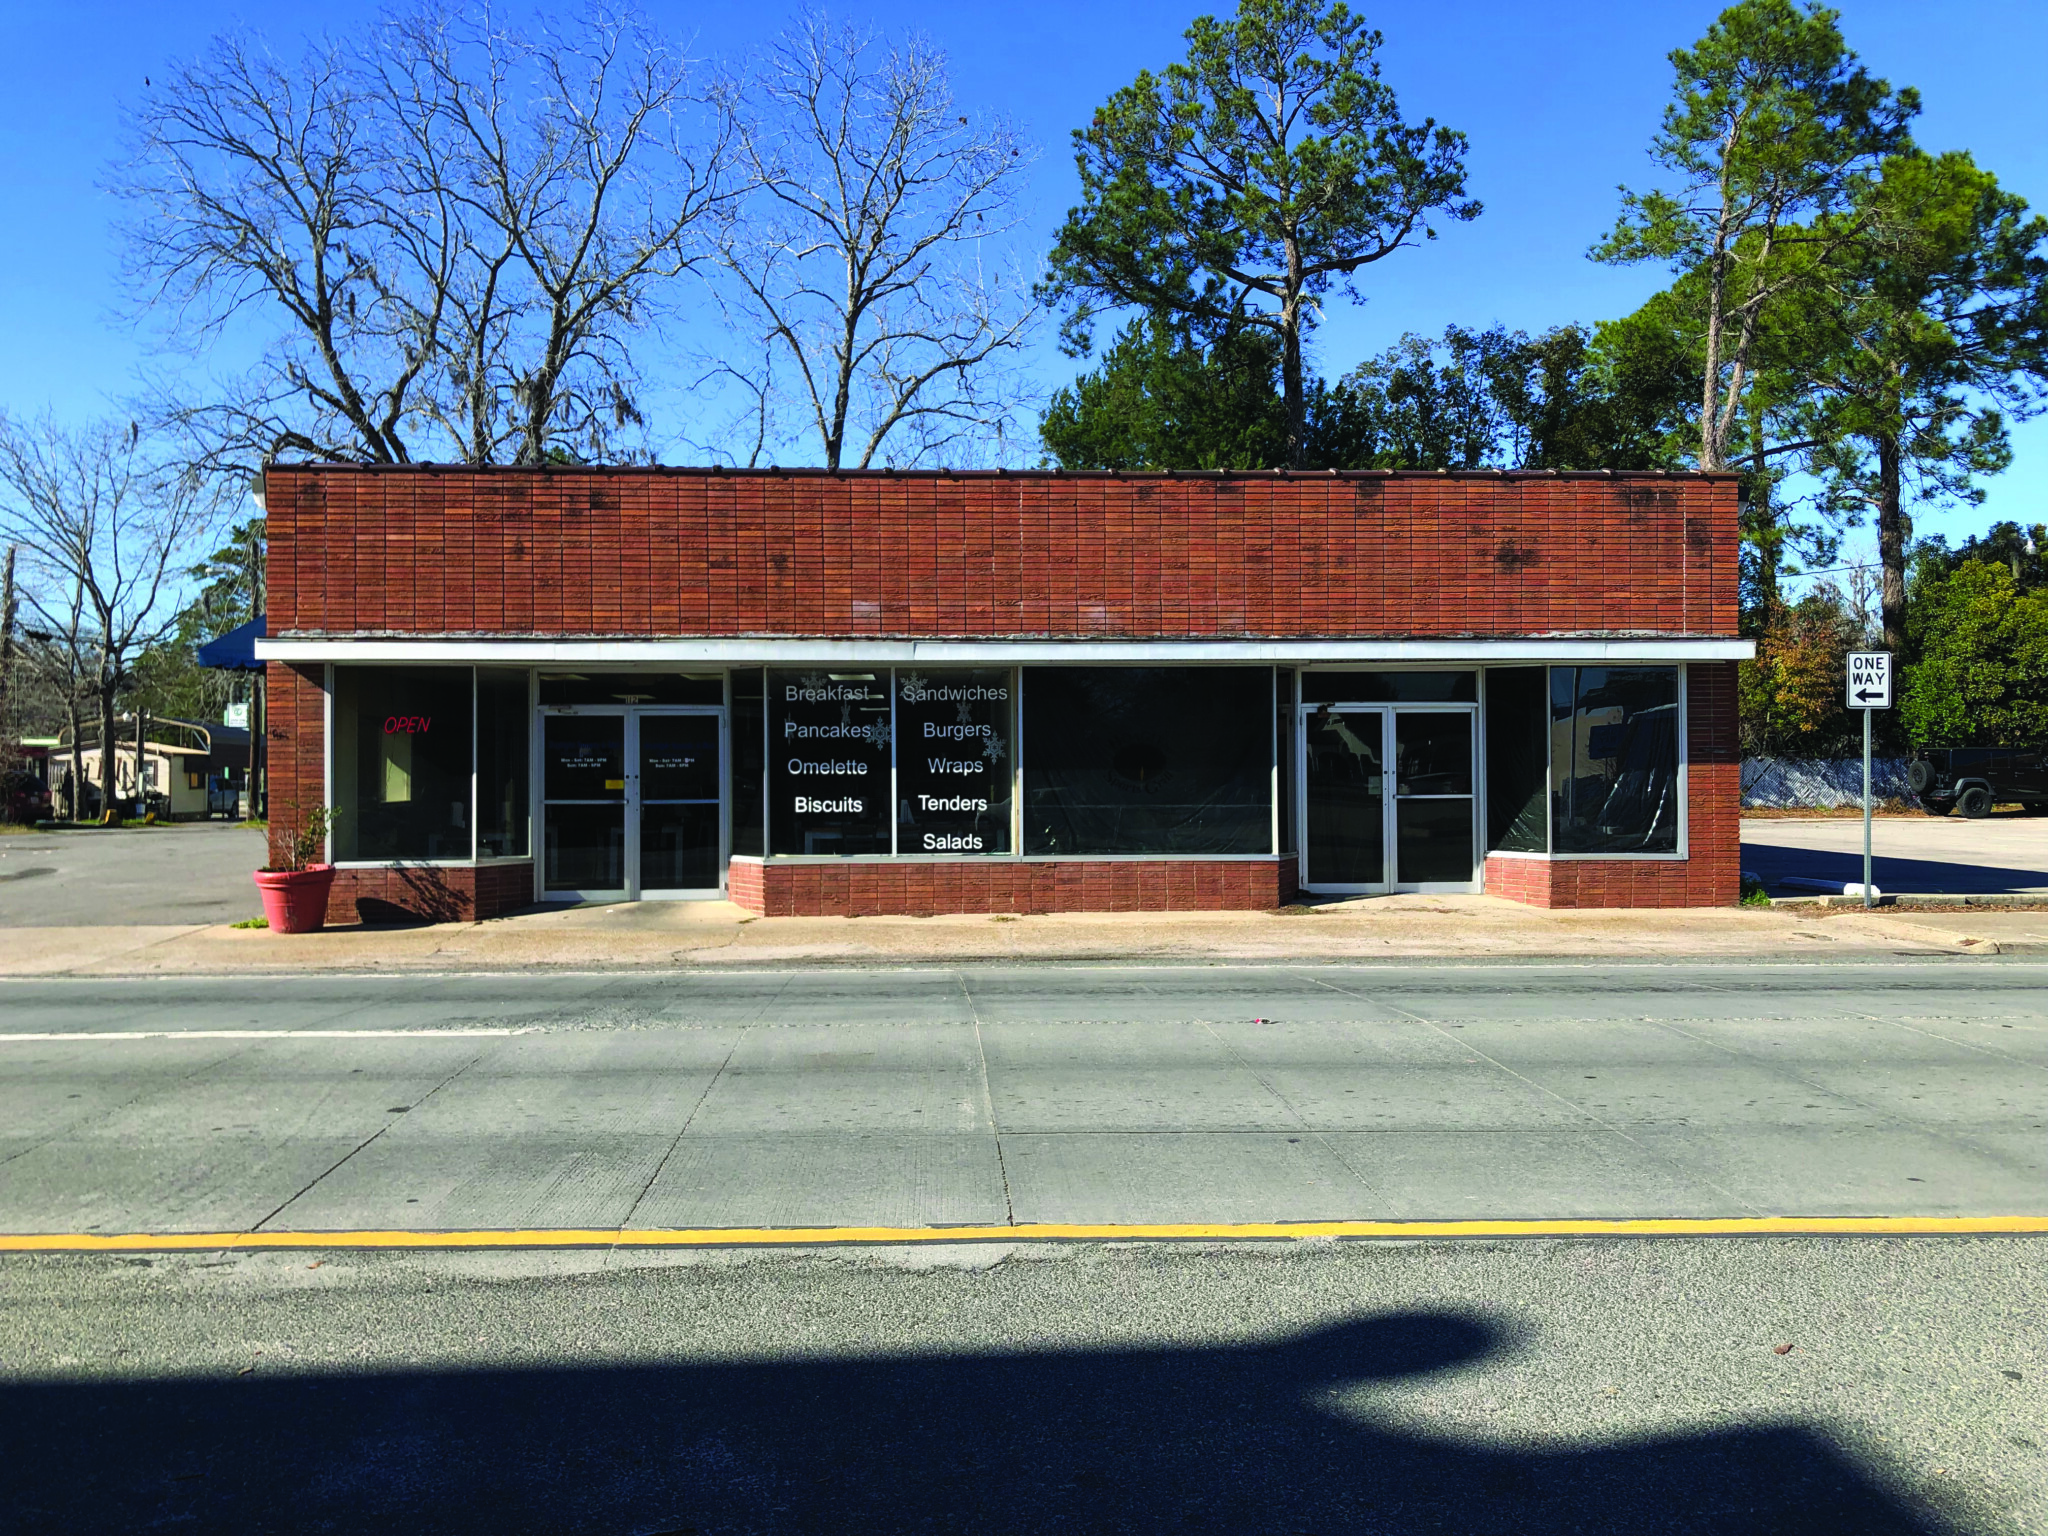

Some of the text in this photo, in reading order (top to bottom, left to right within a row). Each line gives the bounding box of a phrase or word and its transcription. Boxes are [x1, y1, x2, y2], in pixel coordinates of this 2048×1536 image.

[1853, 657, 1884, 670] ONE
[1852, 672, 1885, 685] WAY
[786, 685, 869, 701] Breakfast
[903, 685, 1009, 701] Sandwiches
[384, 716, 431, 734] OPEN
[785, 722, 871, 738] Pancakes
[924, 722, 991, 741] Burgers
[788, 758, 868, 775] Omelette
[928, 758, 984, 776] Wraps
[795, 796, 863, 813] Biscuits
[918, 795, 988, 811] Tenders
[923, 833, 983, 849] Salads
